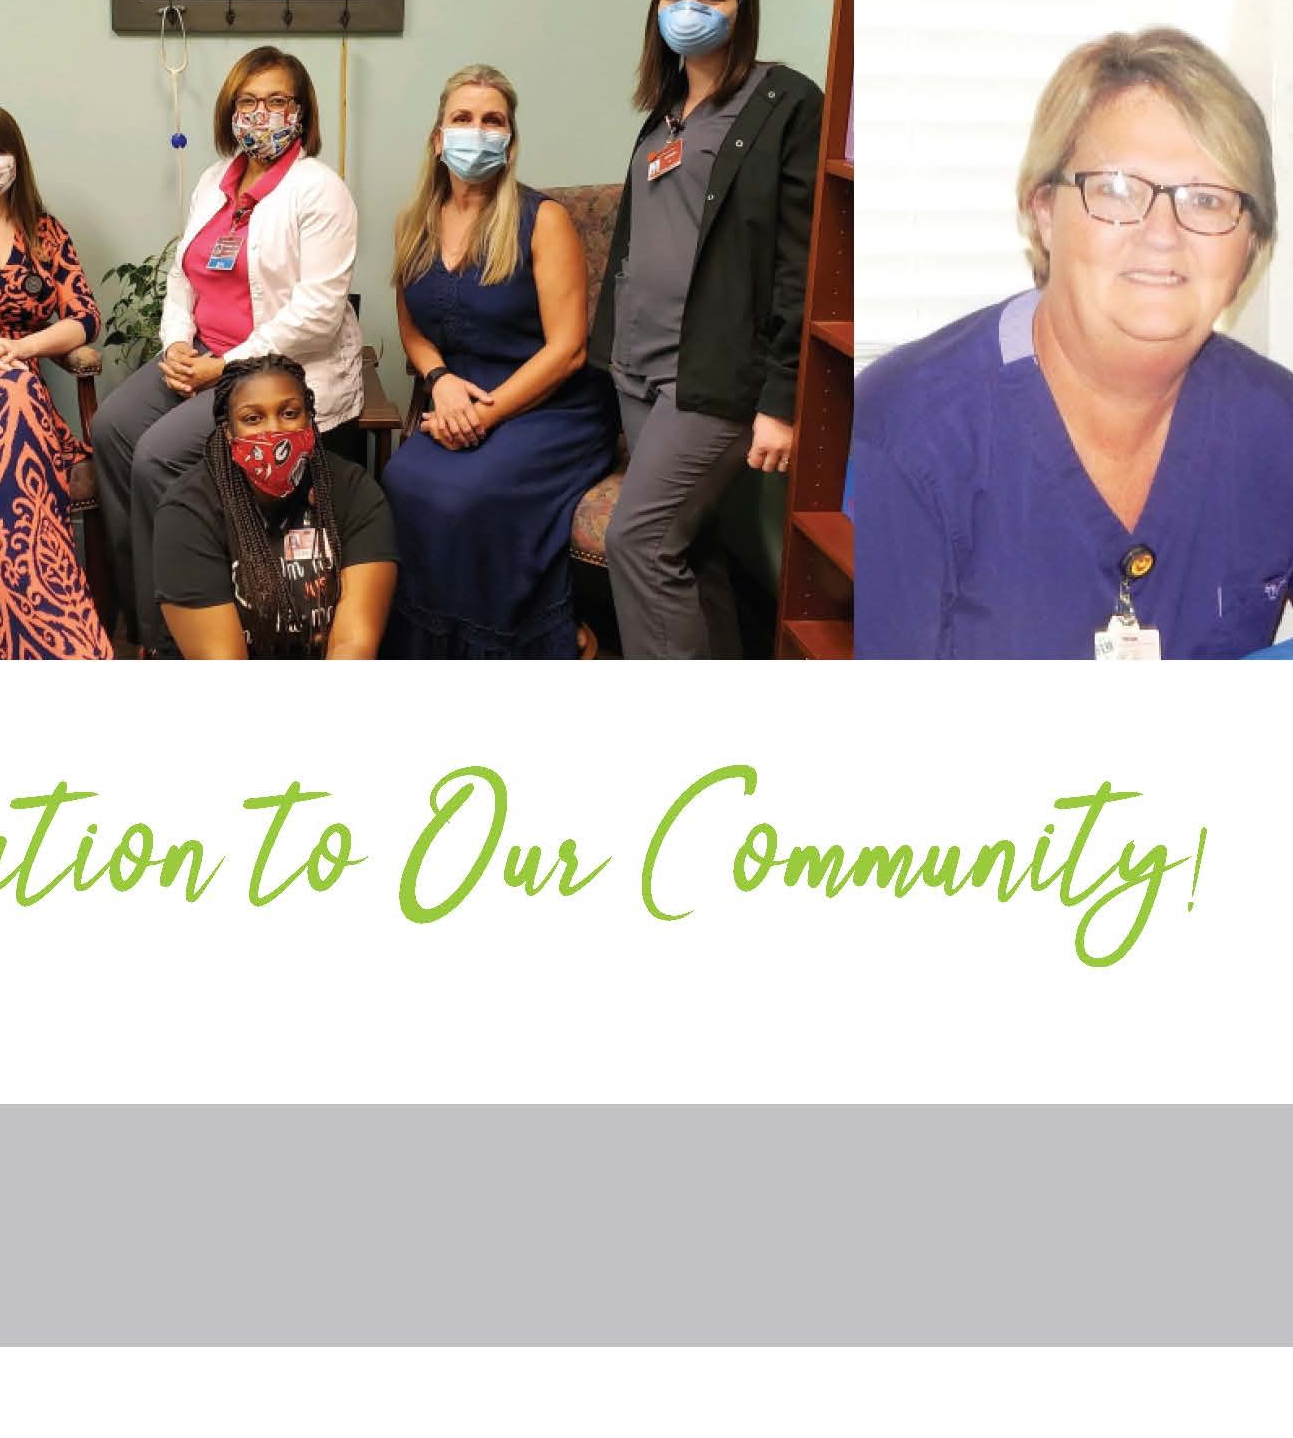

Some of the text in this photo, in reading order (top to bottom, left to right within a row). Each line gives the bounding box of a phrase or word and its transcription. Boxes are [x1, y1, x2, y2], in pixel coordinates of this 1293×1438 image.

[243, 781, 366, 908] to
[399, 766, 613, 924] Our
[642, 765, 1208, 967] Community!
